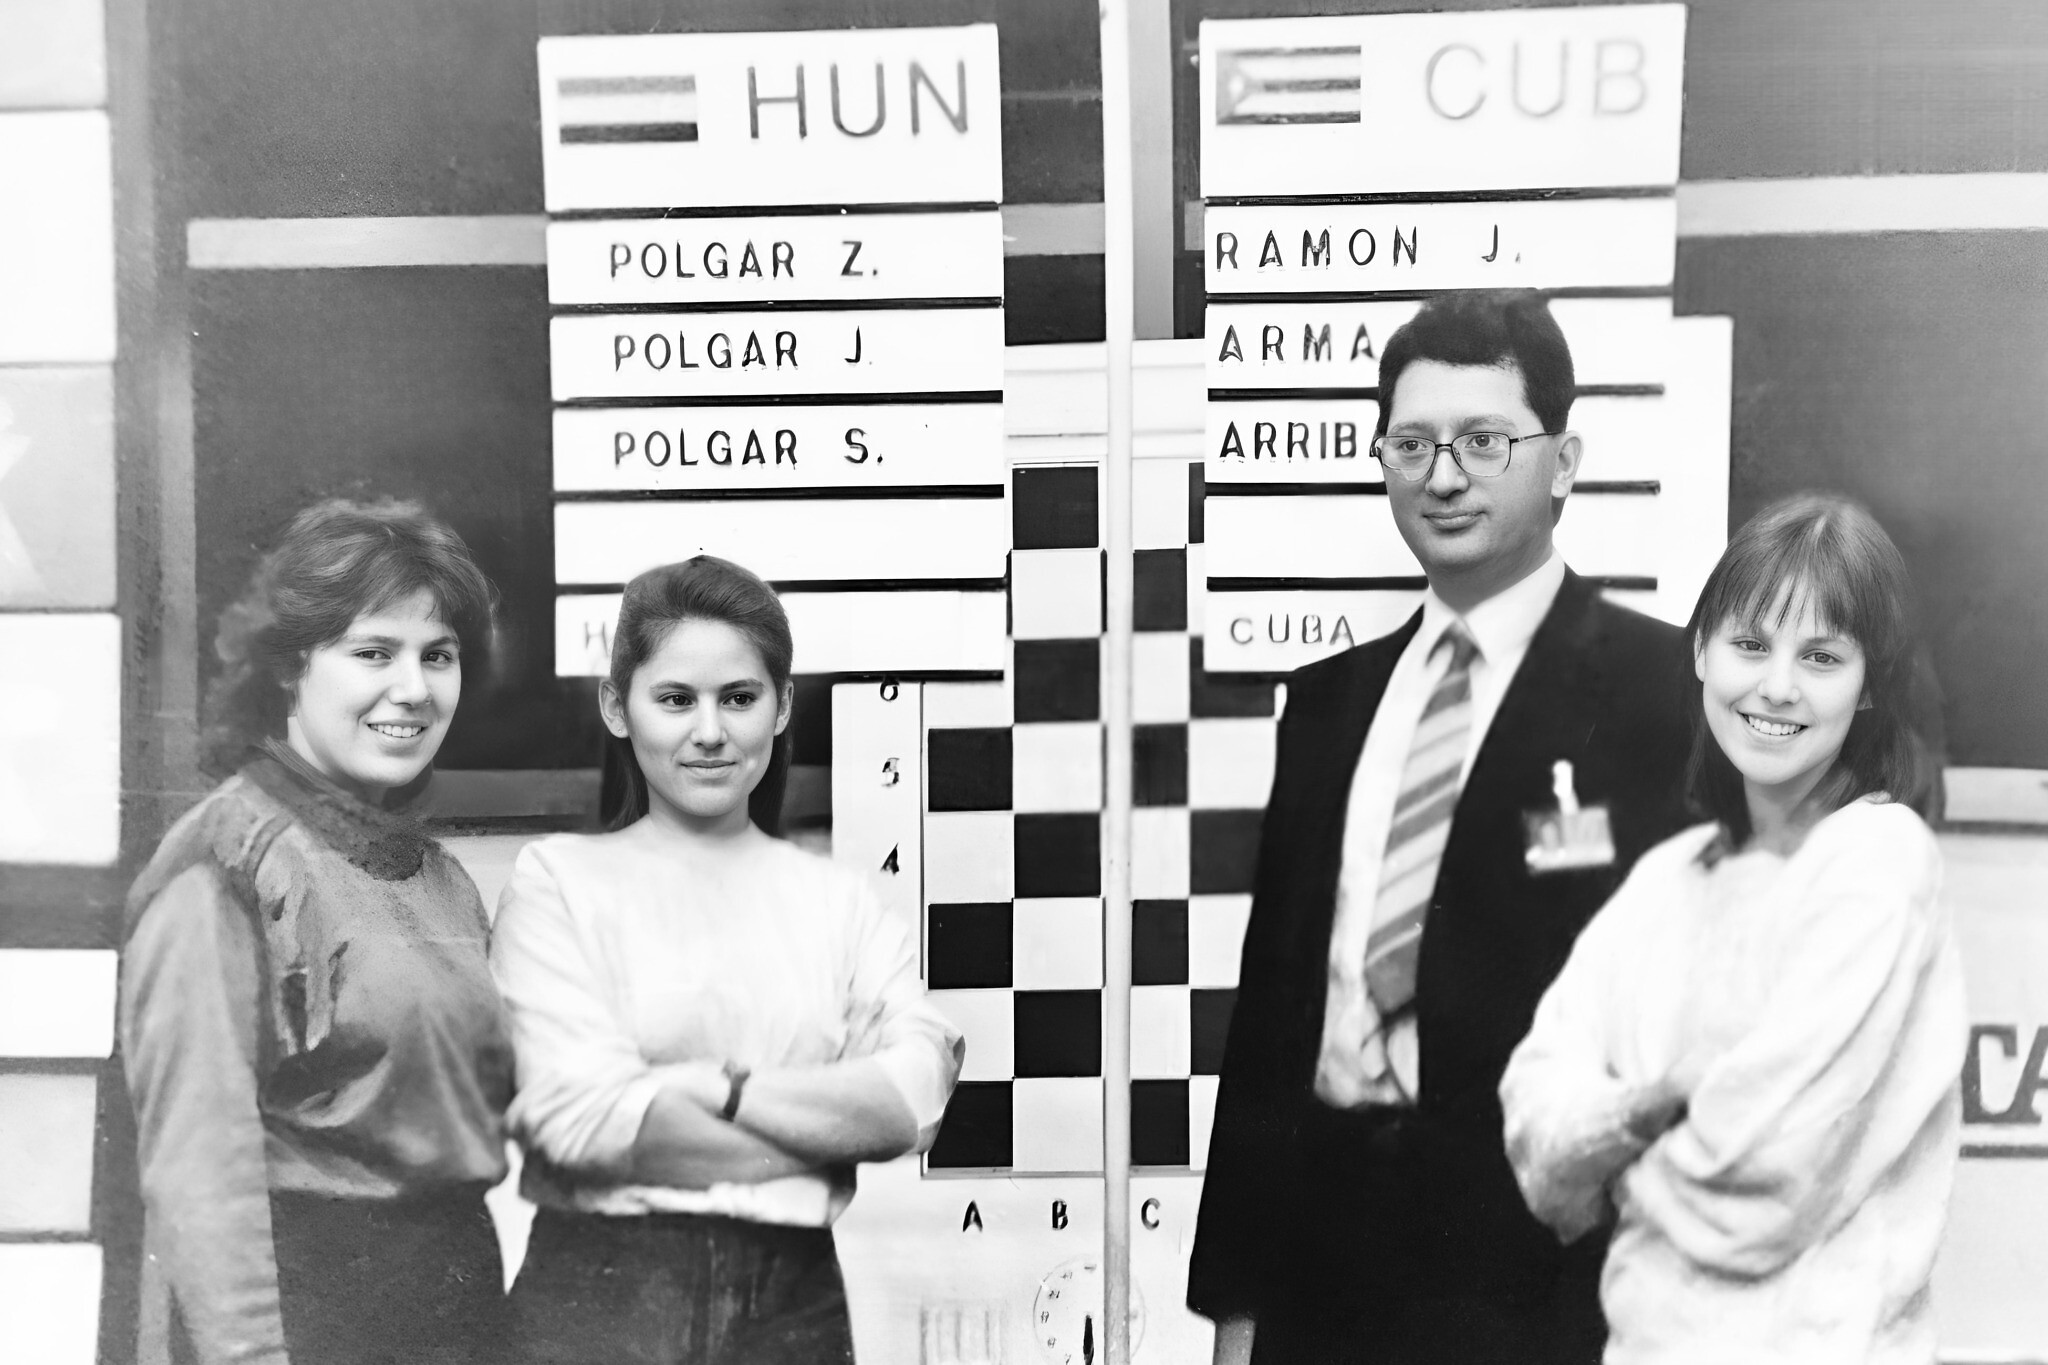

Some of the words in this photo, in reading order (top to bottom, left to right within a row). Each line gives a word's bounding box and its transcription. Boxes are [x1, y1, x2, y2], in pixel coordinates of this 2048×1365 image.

[746, 59, 969, 141] HUN
[1424, 38, 1649, 121] CUB
[609, 240, 795, 280] POLGAR
[840, 240, 879, 277] Z.
[1216, 225, 1418, 270] RAMON
[1480, 224, 1522, 264] J.
[613, 329, 799, 371] POLGAR
[614, 427, 799, 469] POLGAR
[843, 427, 884, 466] S.
[1219, 420, 1381, 462] ARRIB
[1230, 613, 1355, 648] CUBA
[962, 1200, 984, 1233] A
[1051, 1199, 1070, 1231] B
[1140, 1197, 1161, 1231] C
